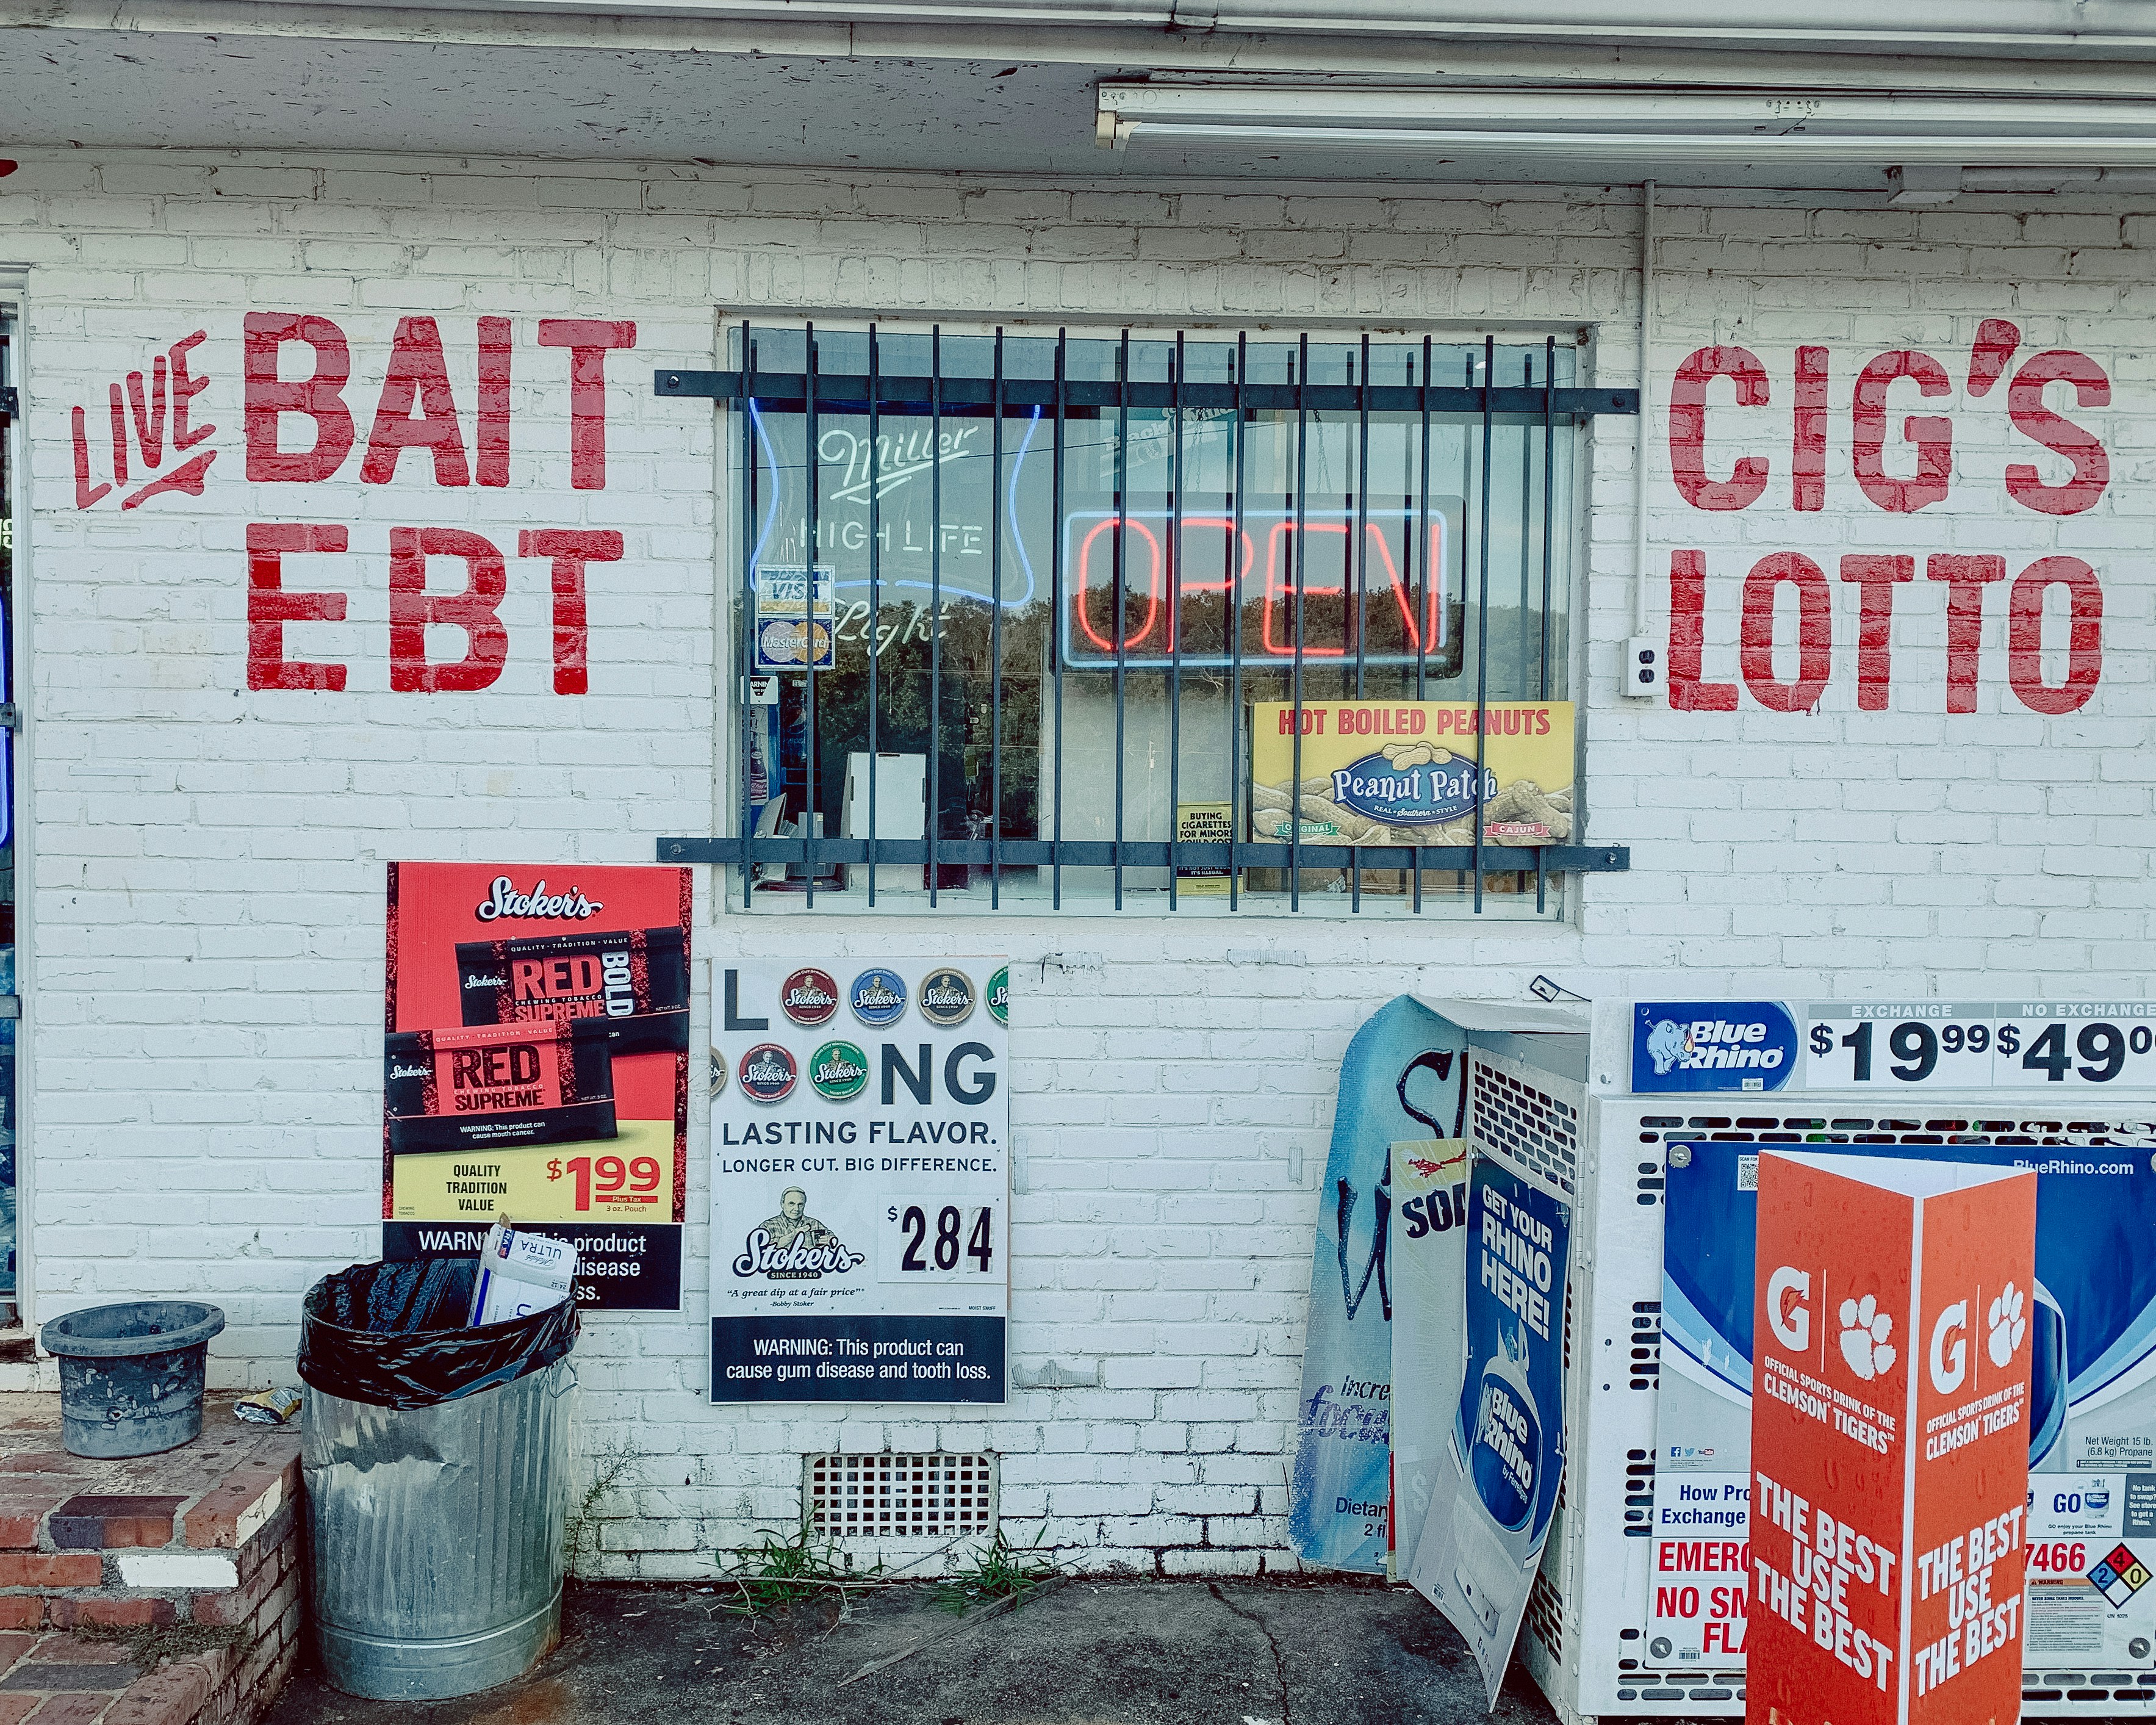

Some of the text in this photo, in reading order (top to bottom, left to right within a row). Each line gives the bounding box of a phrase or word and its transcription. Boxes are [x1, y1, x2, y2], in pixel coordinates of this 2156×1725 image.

[71, 312, 636, 510] LIVE BAIT
[1669, 319, 2111, 515] CIG'S
[818, 426, 979, 486] Miller
[800, 517, 983, 554] HIGH LIFE
[1077, 518, 1440, 655] OPEN
[246, 523, 623, 695] EBT
[1667, 549, 2103, 715] LOTTO
[1279, 709, 1550, 735] HOT BOILED PEANUTS
[1334, 768, 1498, 803] Peanut Patch
[1374, 804, 1457, 818] REAL Southern STYLE
[1499, 824, 1536, 833] CAJUN
[477, 875, 604, 920] Stoker's
[464, 974, 508, 989] Stoker's
[512, 954, 603, 1001] RED
[602, 951, 634, 1017] BOLD
[724, 969, 769, 1031] L
[785, 989, 836, 1007] Stoker's
[854, 990, 905, 1007] Stoker's
[922, 988, 973, 1006] Stoker's
[516, 1000, 606, 1023] SUPREME
[1852, 1004, 1952, 1018] EXCHANGE
[2022, 1004, 2047, 1017] NO
[476, 1030, 520, 1039] TRADITION
[1691, 1020, 1767, 1043] Blue
[451, 1045, 541, 1089] RED
[1680, 1045, 1784, 1069] Rhino
[390, 1065, 433, 1079] Stoker's
[742, 1064, 796, 1082] Stoker's
[814, 1063, 867, 1083] Stoker's
[880, 1042, 997, 1106] NG
[455, 1090, 544, 1111] SUPREME
[460, 1125, 493, 1133] WARNING:
[509, 1122, 533, 1131] product
[723, 1121, 997, 1145] LASTING FLAVOR.
[453, 1165, 501, 1178] QUALITY
[723, 1158, 997, 1173] LONGER CUT. BIG DIFFERENCE.
[446, 1181, 507, 1194] TRADITION
[458, 1199, 494, 1211] VALUE
[1482, 1184, 1553, 1251] GET YOUR
[522, 1241, 562, 1259] ULTRA
[574, 1233, 647, 1253] product
[888, 1205, 993, 1272] $2.84
[733, 1228, 865, 1278] Stoker's
[1482, 1218, 1551, 1292] RHINO
[572, 1259, 641, 1277] disease
[742, 1289, 768, 1298] great
[771, 1288, 786, 1298] dip
[808, 1287, 828, 1298] fair
[1481, 1250, 1550, 1342] HERE!
[1767, 1266, 1811, 1351] G
[754, 1339, 964, 1359] WARNING: This product can
[1930, 1299, 1967, 1394] G
[726, 1361, 991, 1381] cause gum disease and tooth loss.
[1764, 1355, 1896, 1431] OFFICIAL SPORTS DRINK OF THE
[1492, 1387, 1528, 1444] Blue
[1927, 1381, 2025, 1434] OFFICIAL SPORTS DRINK OF THE
[1484, 1417, 1533, 1489] Rhino
[2085, 1436, 2153, 1447] Net Weight 15 lb.
[2088, 1447, 2153, 1458] (6.8 kg) Propane
[1502, 1464, 1509, 1479] by
[1680, 1485, 1717, 1500] How
[2054, 1493, 2081, 1513] GO
[1662, 1508, 1745, 1528] Exchange
[1364, 1524, 1373, 1536] 2
[1756, 1471, 1896, 1597] THE BEST
[1917, 1505, 2024, 1602] THE BEST
[2113, 1552, 2125, 1567] 4
[1791, 1536, 1849, 1613] USE
[2098, 1568, 2141, 1584] 2 0
[1656, 1587, 1699, 1618] NO
[1949, 1574, 1993, 1630] USE
[1755, 1556, 1894, 1693] THE BEST
[1915, 1636, 1960, 1698] THE
[1965, 1594, 2021, 1668] BEST
